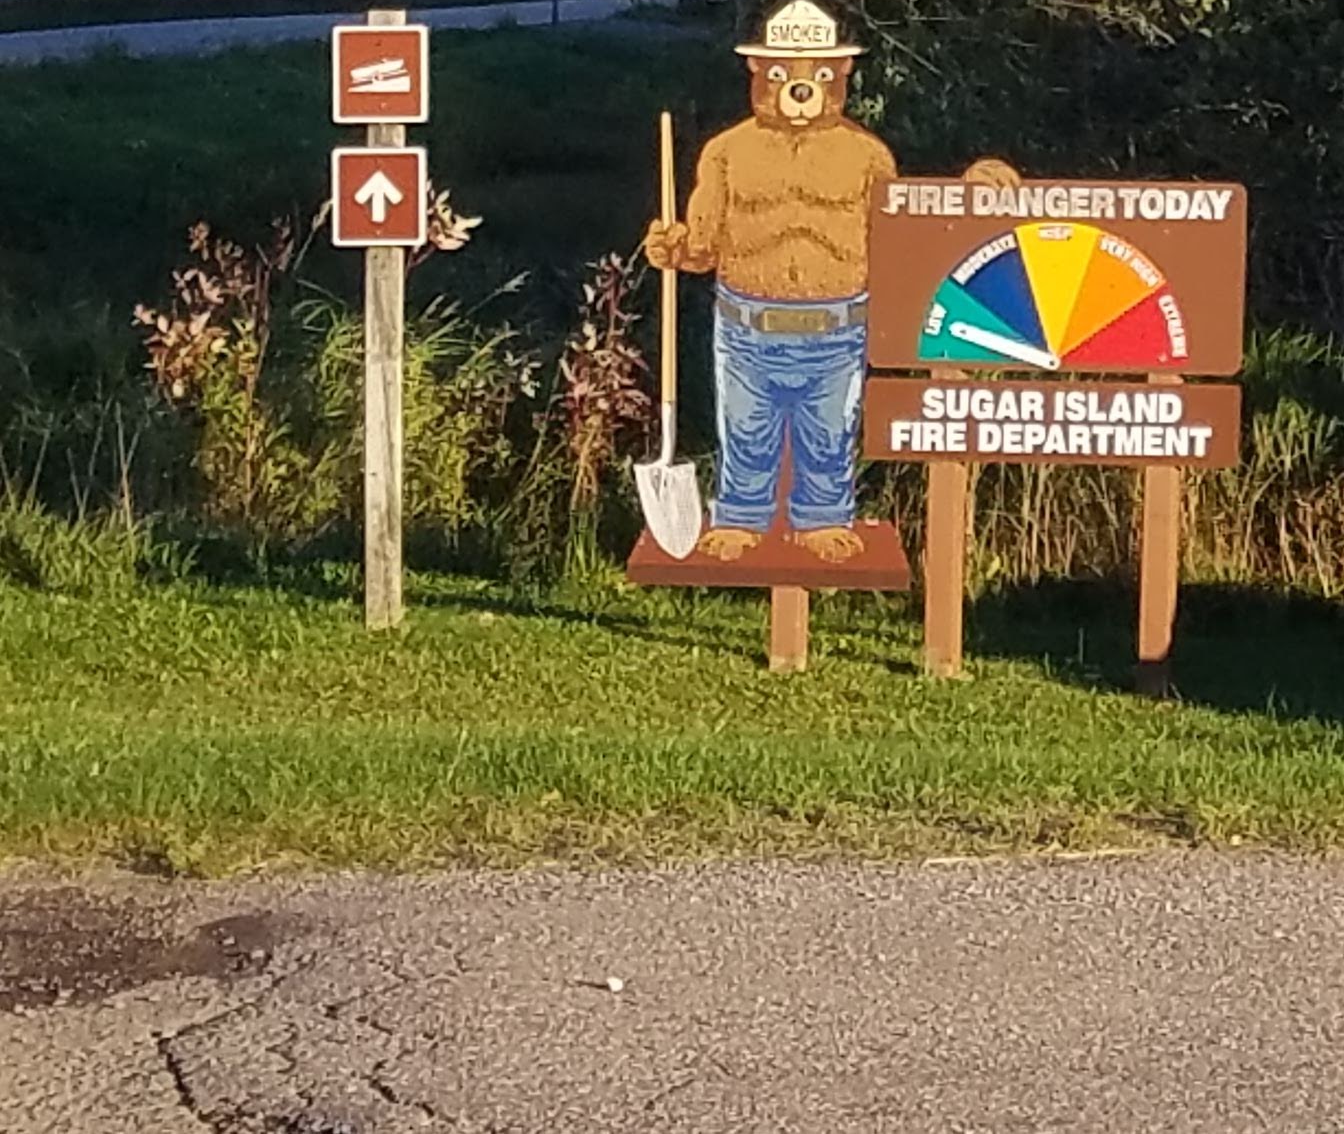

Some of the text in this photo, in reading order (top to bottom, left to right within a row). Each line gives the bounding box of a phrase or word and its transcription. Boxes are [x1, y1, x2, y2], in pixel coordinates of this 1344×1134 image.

[770, 24, 832, 43] SMOKEY
[886, 183, 1233, 221] FIRE DANGER TODAY
[921, 387, 1183, 424] SUGAR ISLAND
[890, 421, 1213, 458] FIRE DEPARTMENT
